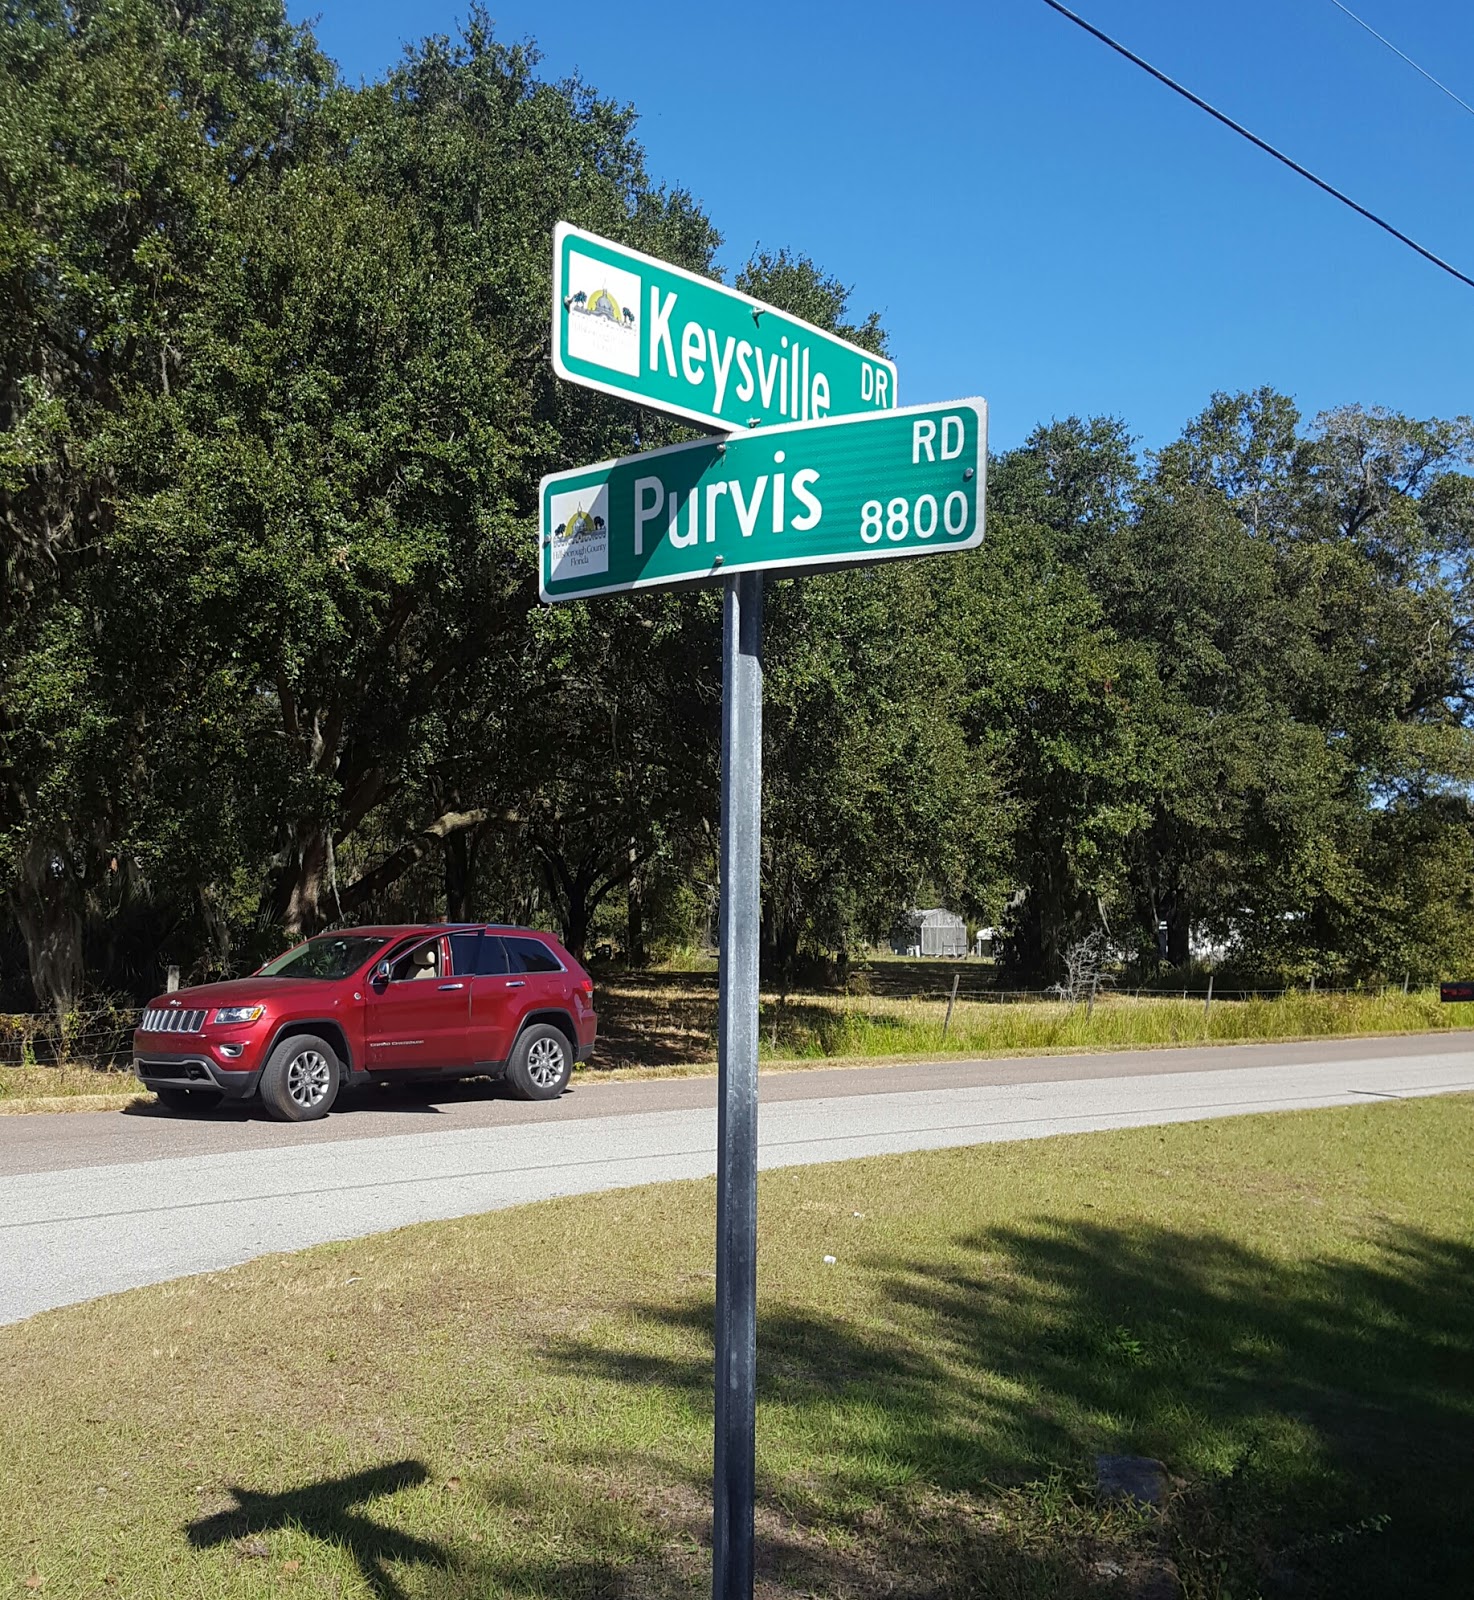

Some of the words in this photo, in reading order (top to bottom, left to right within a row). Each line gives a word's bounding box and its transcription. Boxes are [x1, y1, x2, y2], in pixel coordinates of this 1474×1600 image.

[649, 285, 831, 421] Keysville
[861, 361, 888, 409] DR
[634, 450, 823, 556] Purvis
[911, 415, 965, 464] RD
[860, 490, 968, 544] 8800
[586, 543, 607, 554] County
